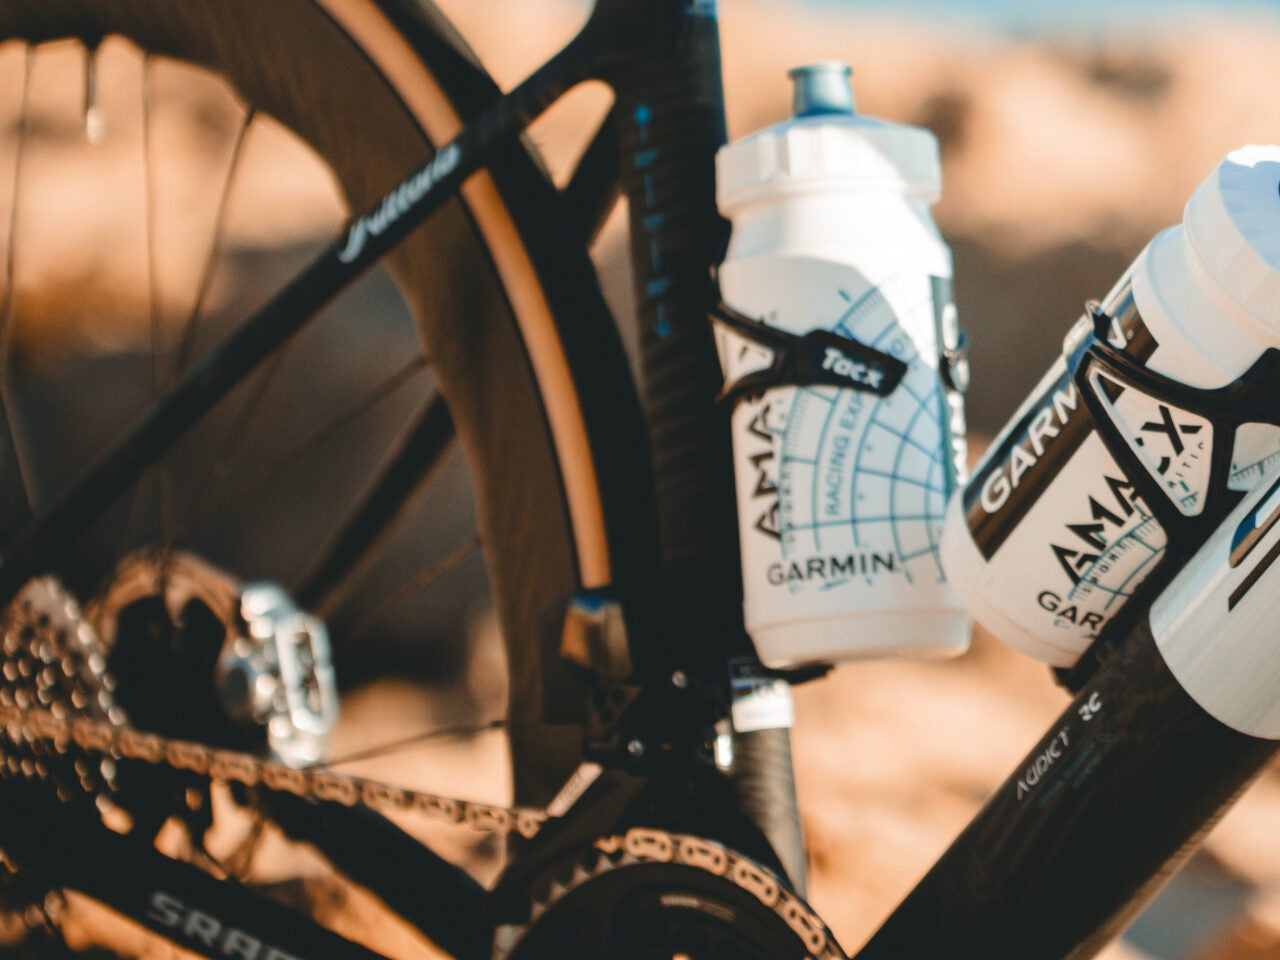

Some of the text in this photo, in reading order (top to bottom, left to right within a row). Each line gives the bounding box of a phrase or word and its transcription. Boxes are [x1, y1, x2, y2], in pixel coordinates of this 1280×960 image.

[362, 143, 460, 238] vittoria
[823, 434, 850, 518] RACING
[766, 553, 896, 586] GARMIN
